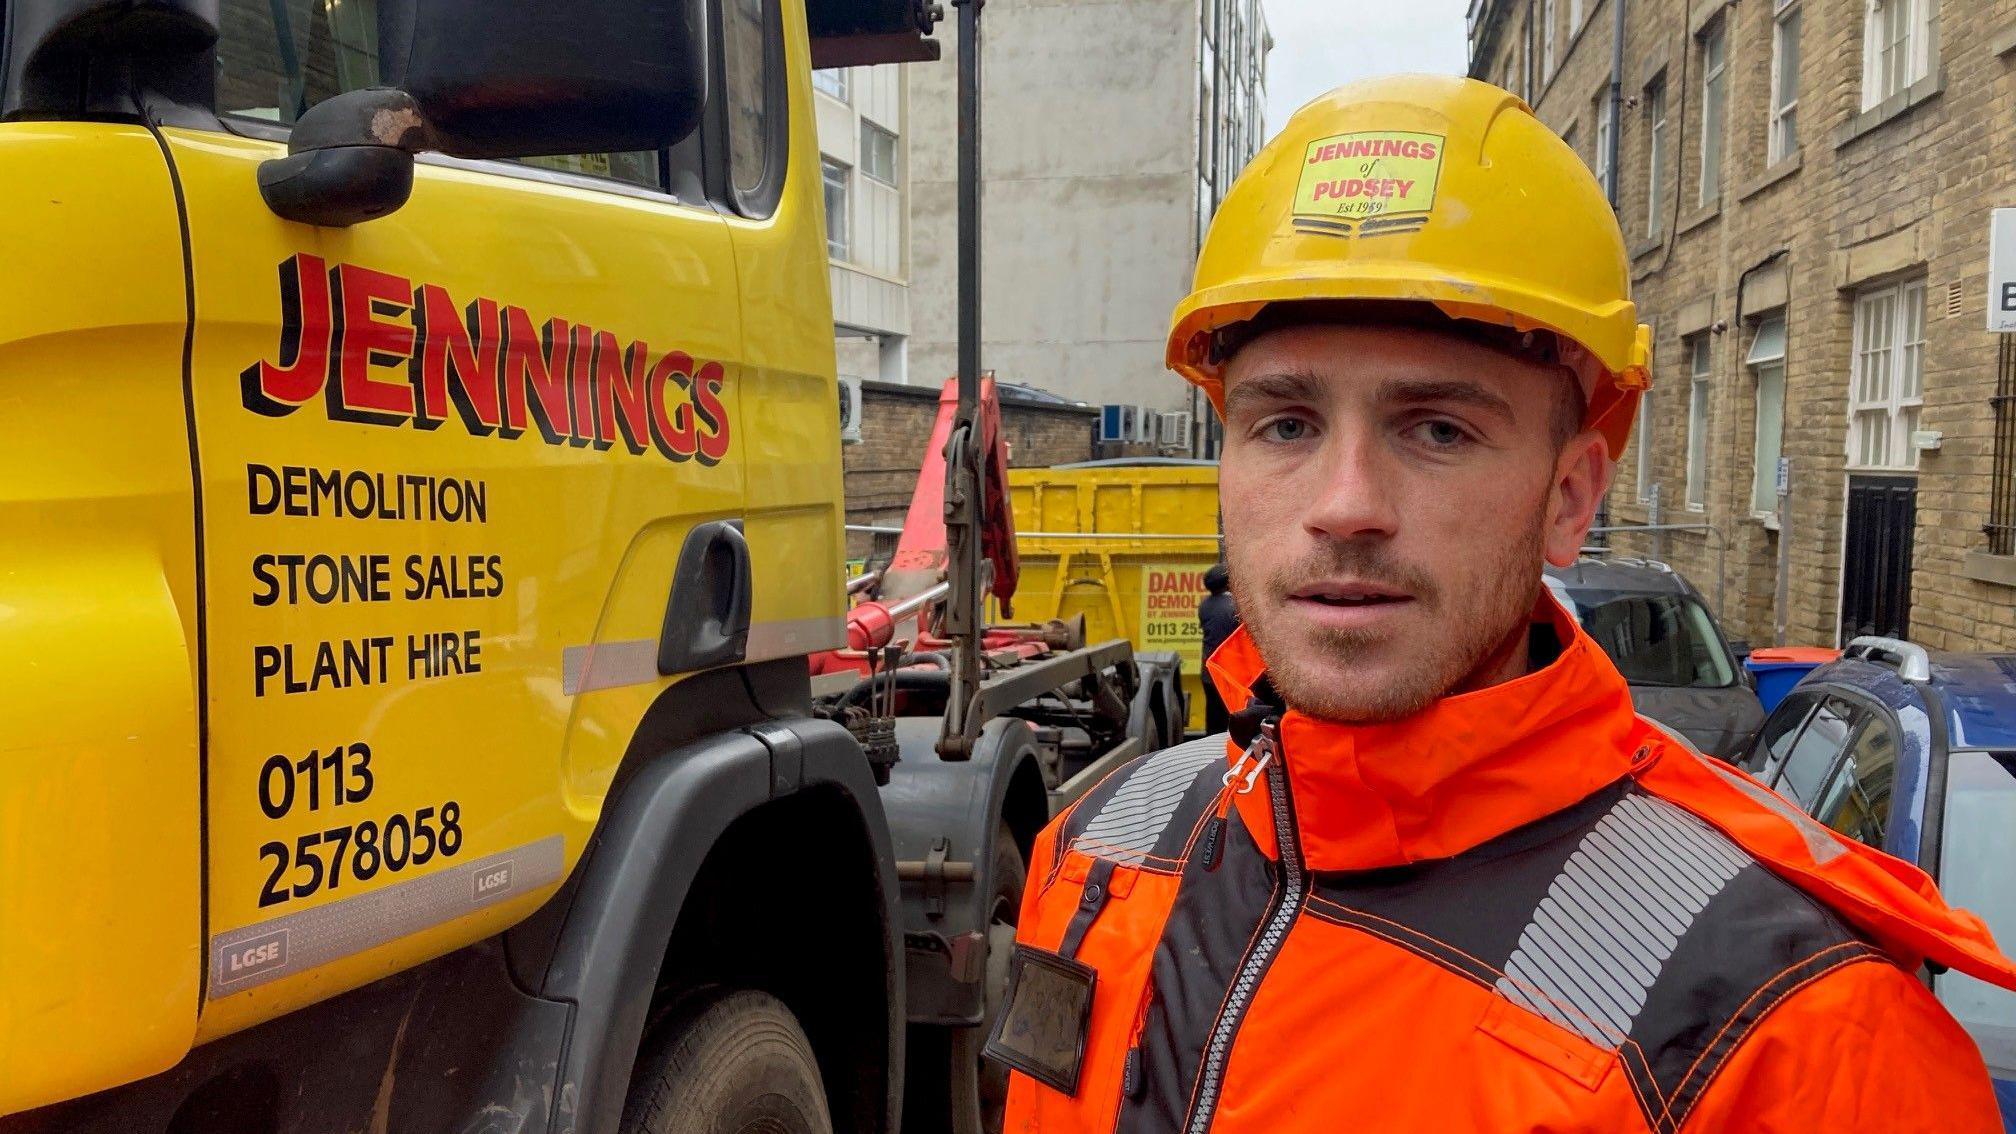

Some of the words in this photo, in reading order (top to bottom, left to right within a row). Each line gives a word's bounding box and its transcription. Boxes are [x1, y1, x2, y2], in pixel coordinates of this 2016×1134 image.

[1308, 139, 1437, 165] JENNINGS
[1359, 158, 1380, 178] of
[1313, 178, 1415, 201] PUDSEY
[1336, 202, 1355, 214] Est
[240, 252, 730, 467] JENNINGS
[247, 463, 487, 524] DEMOLITION
[251, 553, 392, 607] STONE
[404, 554, 504, 601] SALES
[1148, 572, 1208, 592] DANG
[1147, 595, 1200, 609] DEMOL
[1147, 622, 1176, 636] 0113
[253, 637, 394, 698] PLANT
[407, 630, 481, 680] HIRE
[258, 742, 374, 820] 0113
[258, 801, 463, 908] 2578058
[478, 869, 508, 893] LGSE
[230, 941, 279, 971] LGSE
